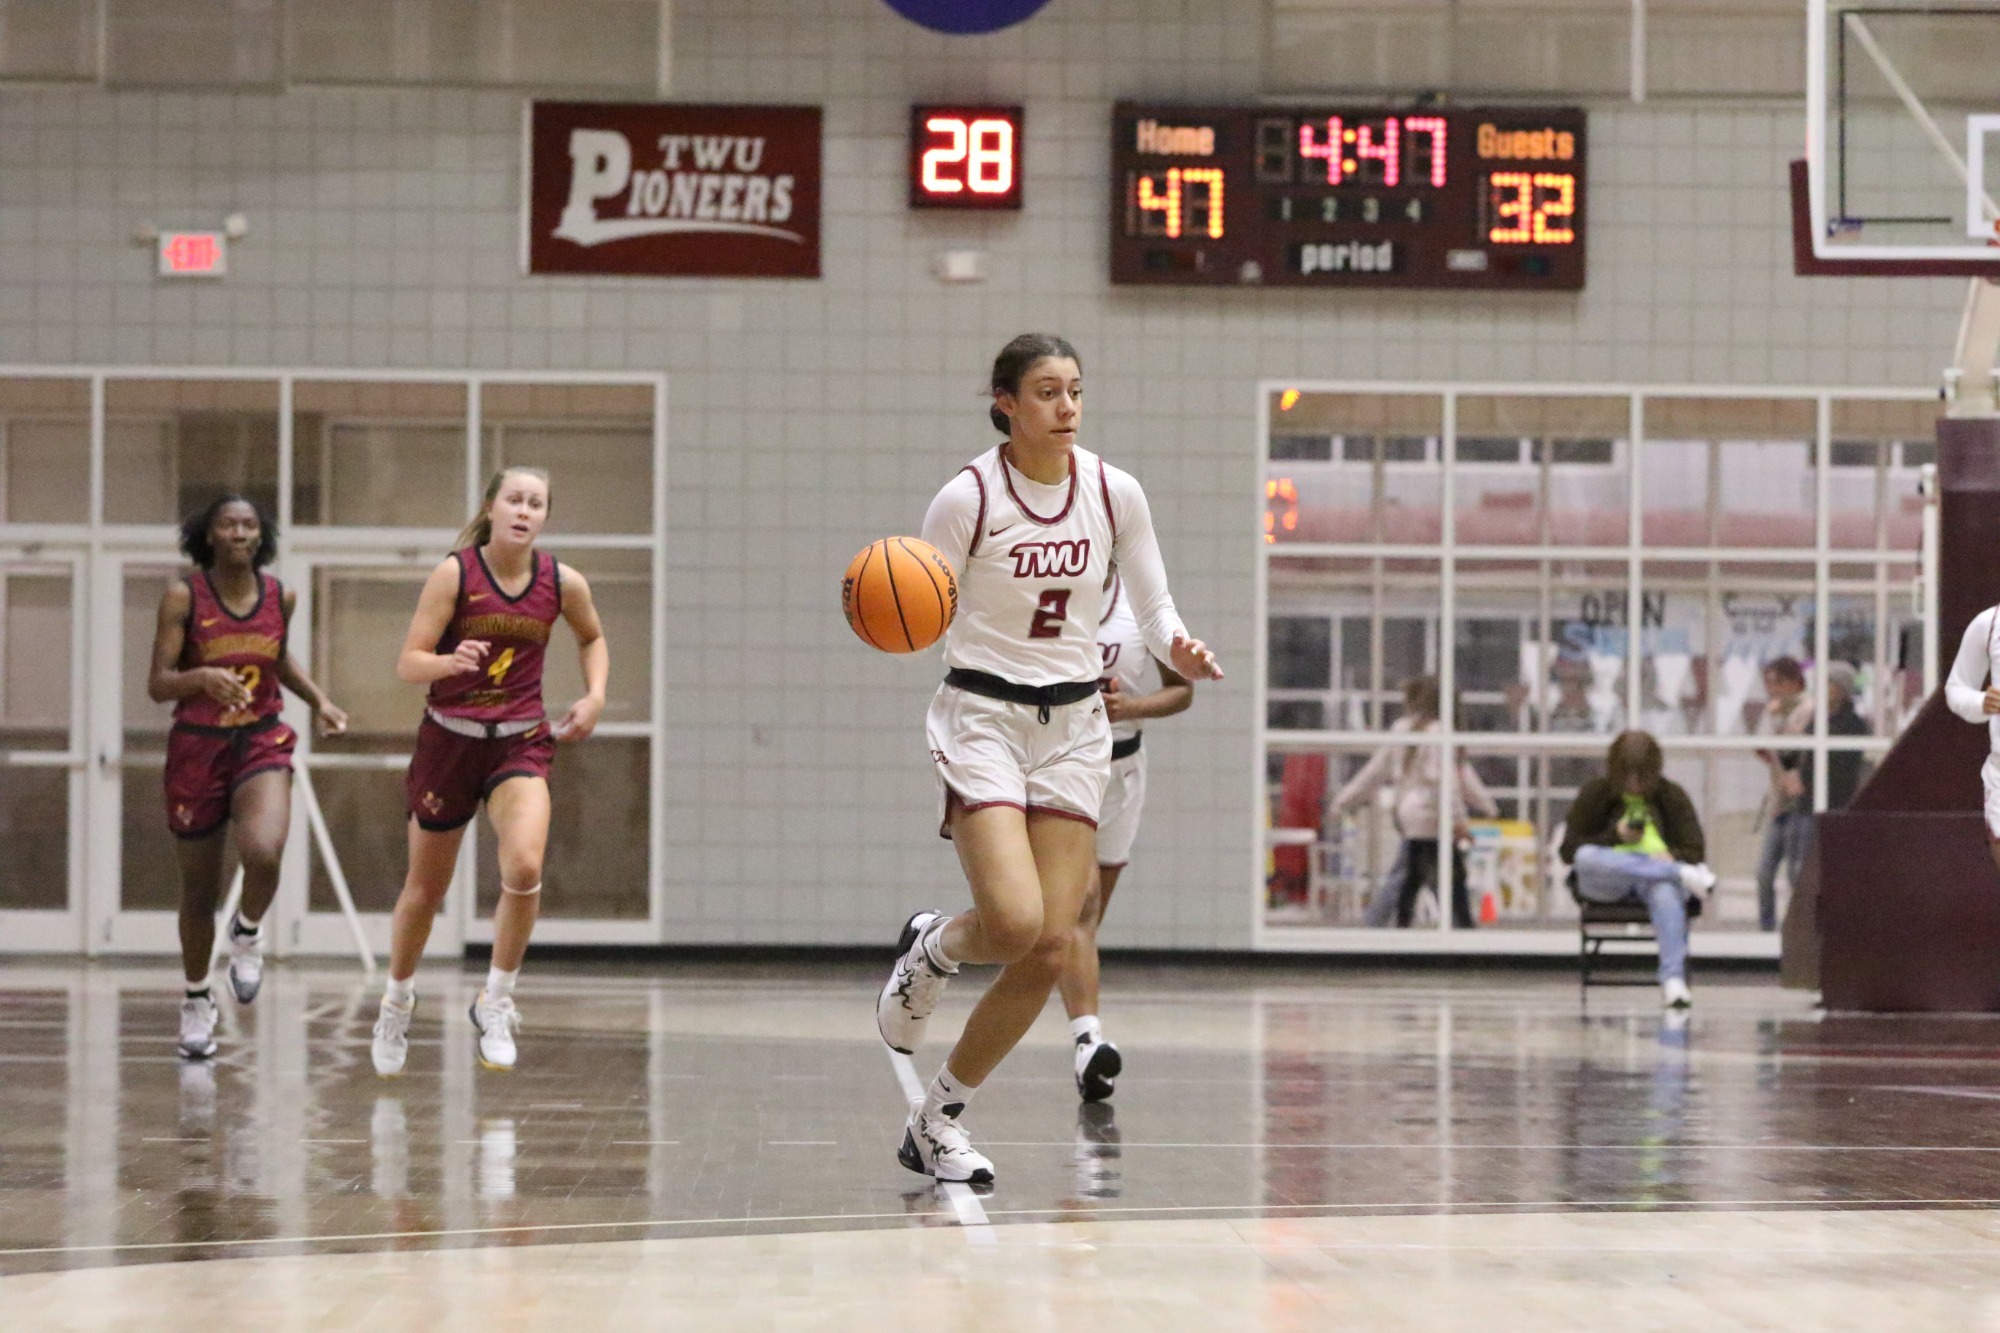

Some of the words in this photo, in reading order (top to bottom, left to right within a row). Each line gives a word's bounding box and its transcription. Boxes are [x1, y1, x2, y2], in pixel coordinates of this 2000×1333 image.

[658, 134, 766, 171] TWU
[922, 118, 1013, 193] 28
[1136, 119, 1215, 155] Home
[1299, 115, 1447, 188] 4:47
[1477, 123, 1575, 159] Guests
[1137, 167, 1225, 239] 47
[1489, 171, 1576, 244] 32
[1301, 240, 1393, 276] period
[1008, 538, 1090, 578] TWU
[1027, 588, 1072, 639] 2
[487, 647, 515, 686] 4
